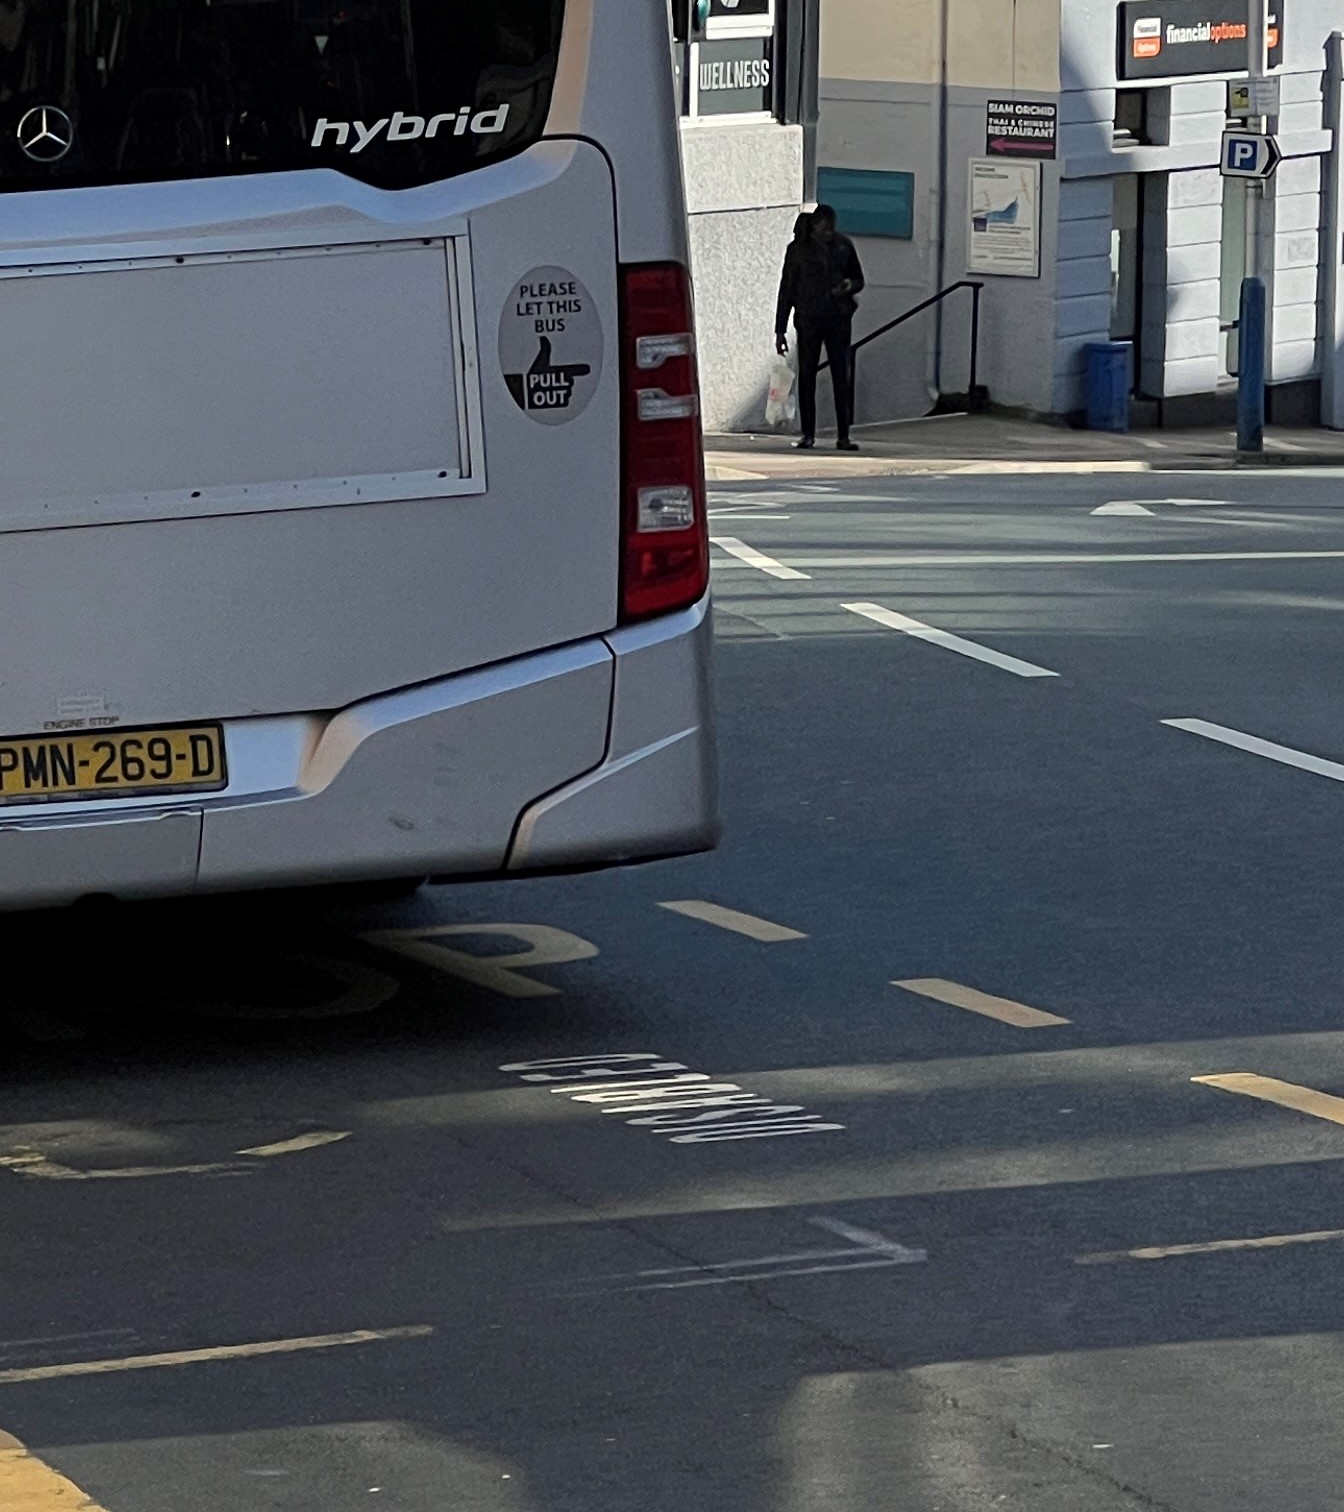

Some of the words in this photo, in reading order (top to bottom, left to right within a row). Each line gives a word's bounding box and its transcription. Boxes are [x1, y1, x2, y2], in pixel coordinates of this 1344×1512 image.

[700, 59, 769, 90] WELLNESS
[988, 103, 1014, 113] SIAM
[1015, 104, 1055, 116] ORCHID
[311, 104, 509, 153] hybrid
[988, 125, 1054, 138] RESTAURANT
[1235, 143, 1253, 167] P
[519, 282, 577, 298] PLEASE
[517, 302, 542, 316] LET
[547, 299, 581, 315] THIS
[534, 319, 566, 333] BUS
[529, 372, 569, 388] PULL
[533, 390, 567, 406] OUT
[44, 718, 85, 731] ENGINE
[89, 716, 119, 727] STOP
